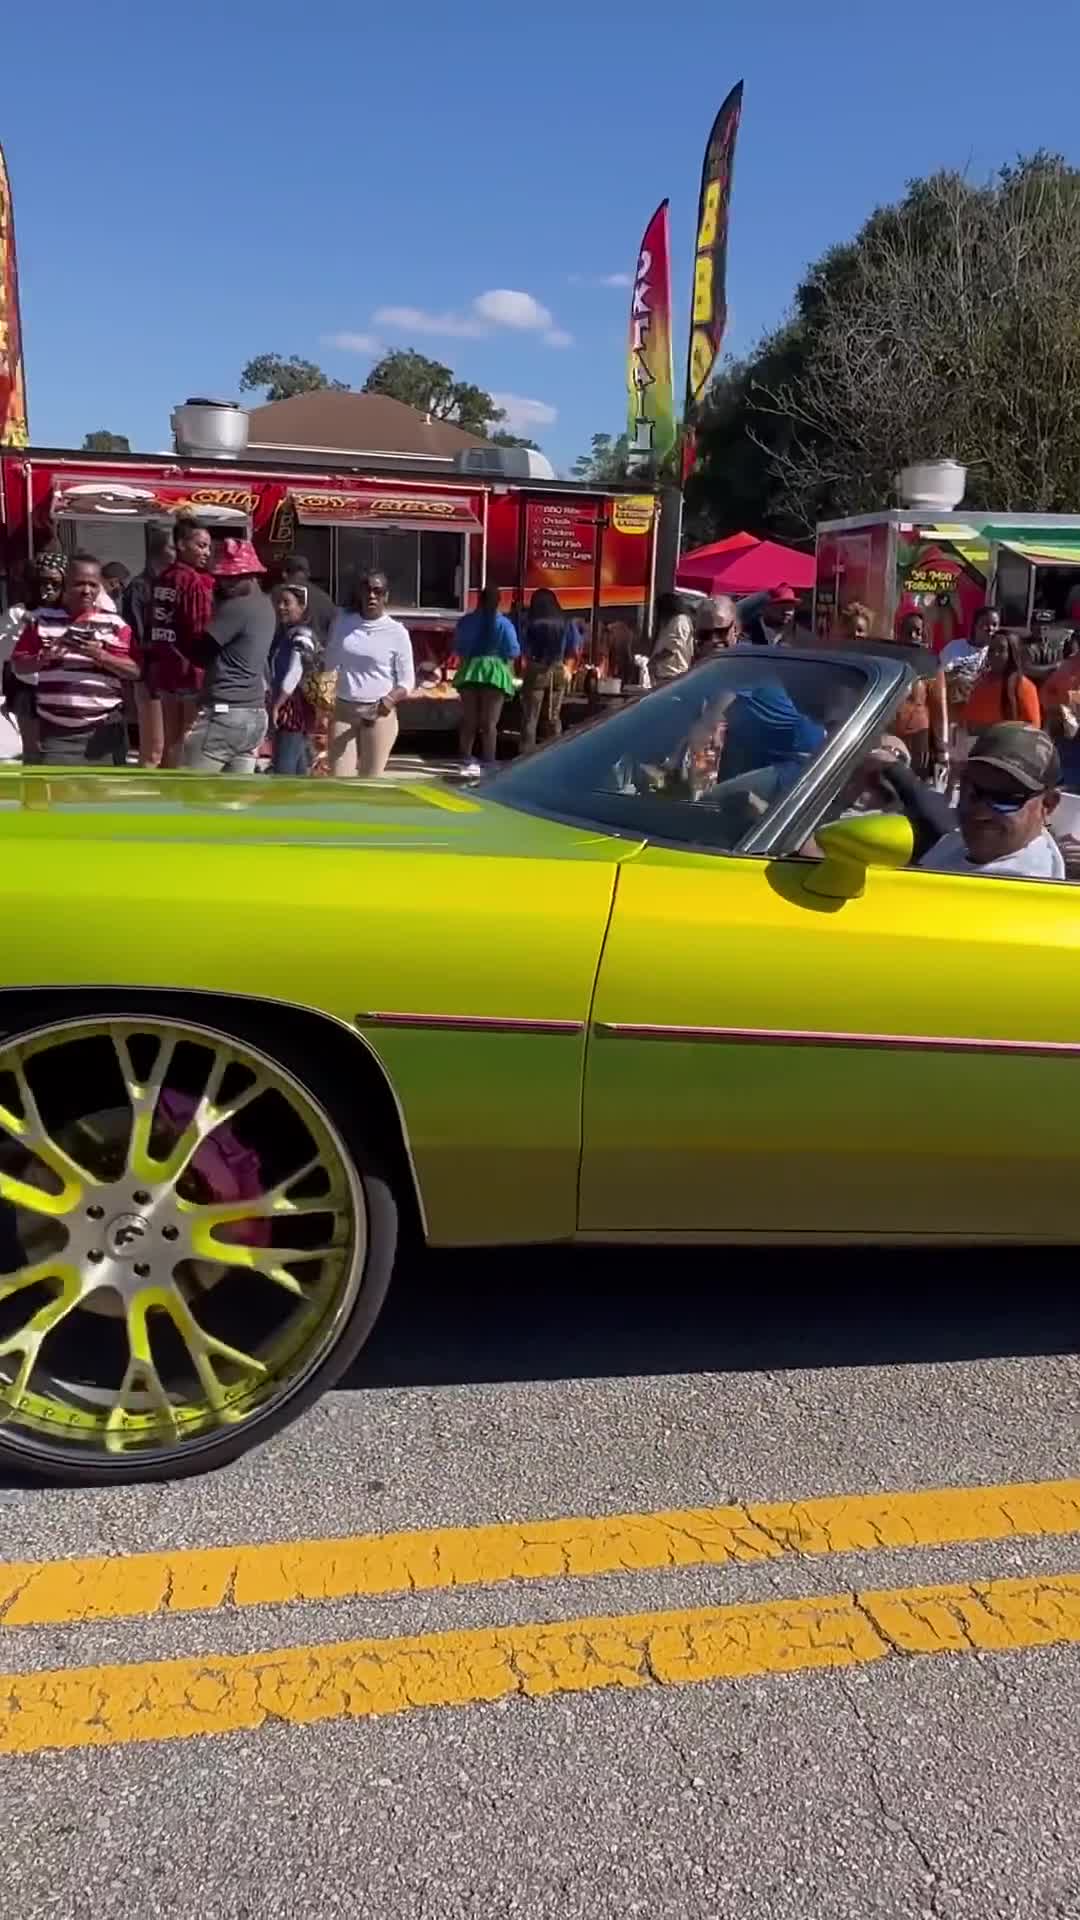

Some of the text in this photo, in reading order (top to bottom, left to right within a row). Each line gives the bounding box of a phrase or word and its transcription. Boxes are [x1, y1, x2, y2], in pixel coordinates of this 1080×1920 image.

[542, 528, 575, 537] Chicken
[542, 540, 582, 548] Fried Fish
[542, 550, 592, 560] Turkey Legs
